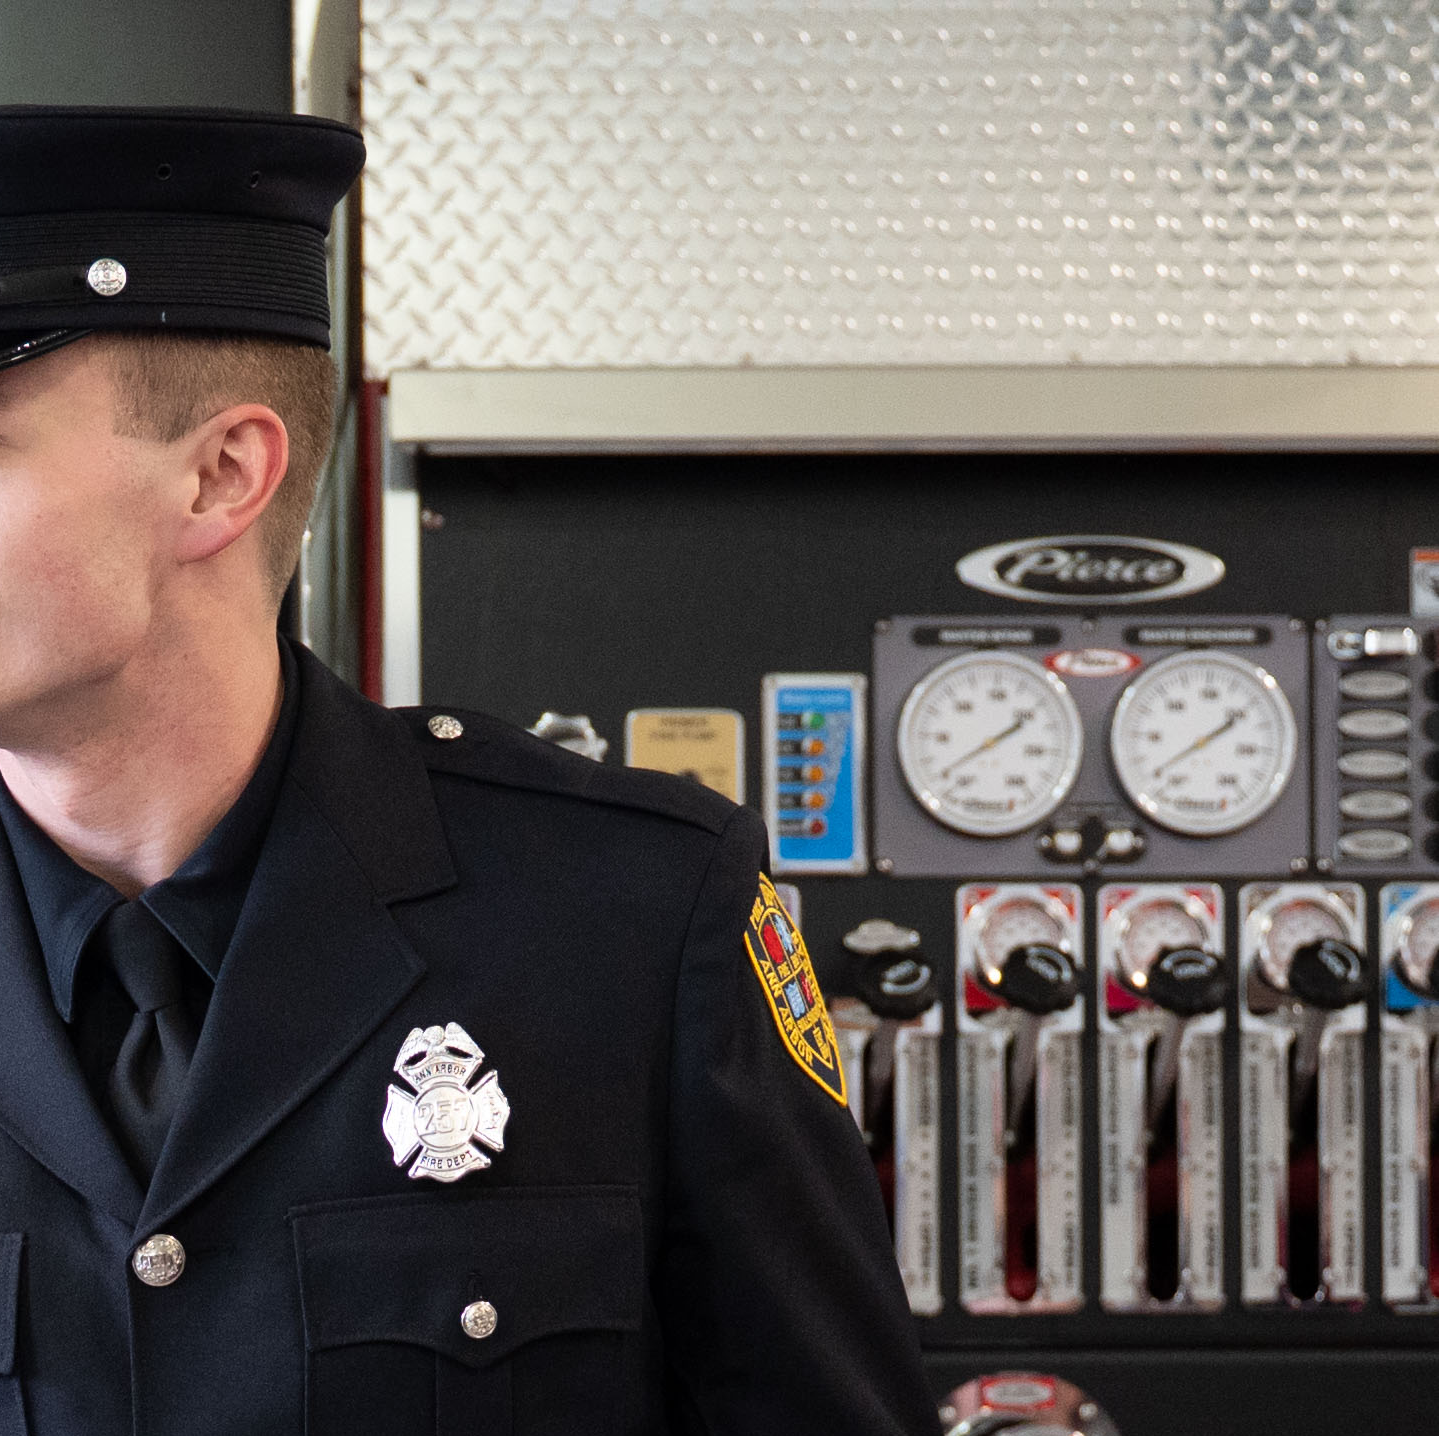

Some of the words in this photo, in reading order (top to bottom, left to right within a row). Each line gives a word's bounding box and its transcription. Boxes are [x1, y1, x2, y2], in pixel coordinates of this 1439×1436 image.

[1003, 547, 1179, 585] Pierce
[778, 1006, 815, 1067] ARBOR
[413, 1068, 433, 1084] ANN
[434, 1063, 467, 1076] ARBOR
[421, 1155, 443, 1169] FIRE
[446, 1150, 473, 1168] DEPT
